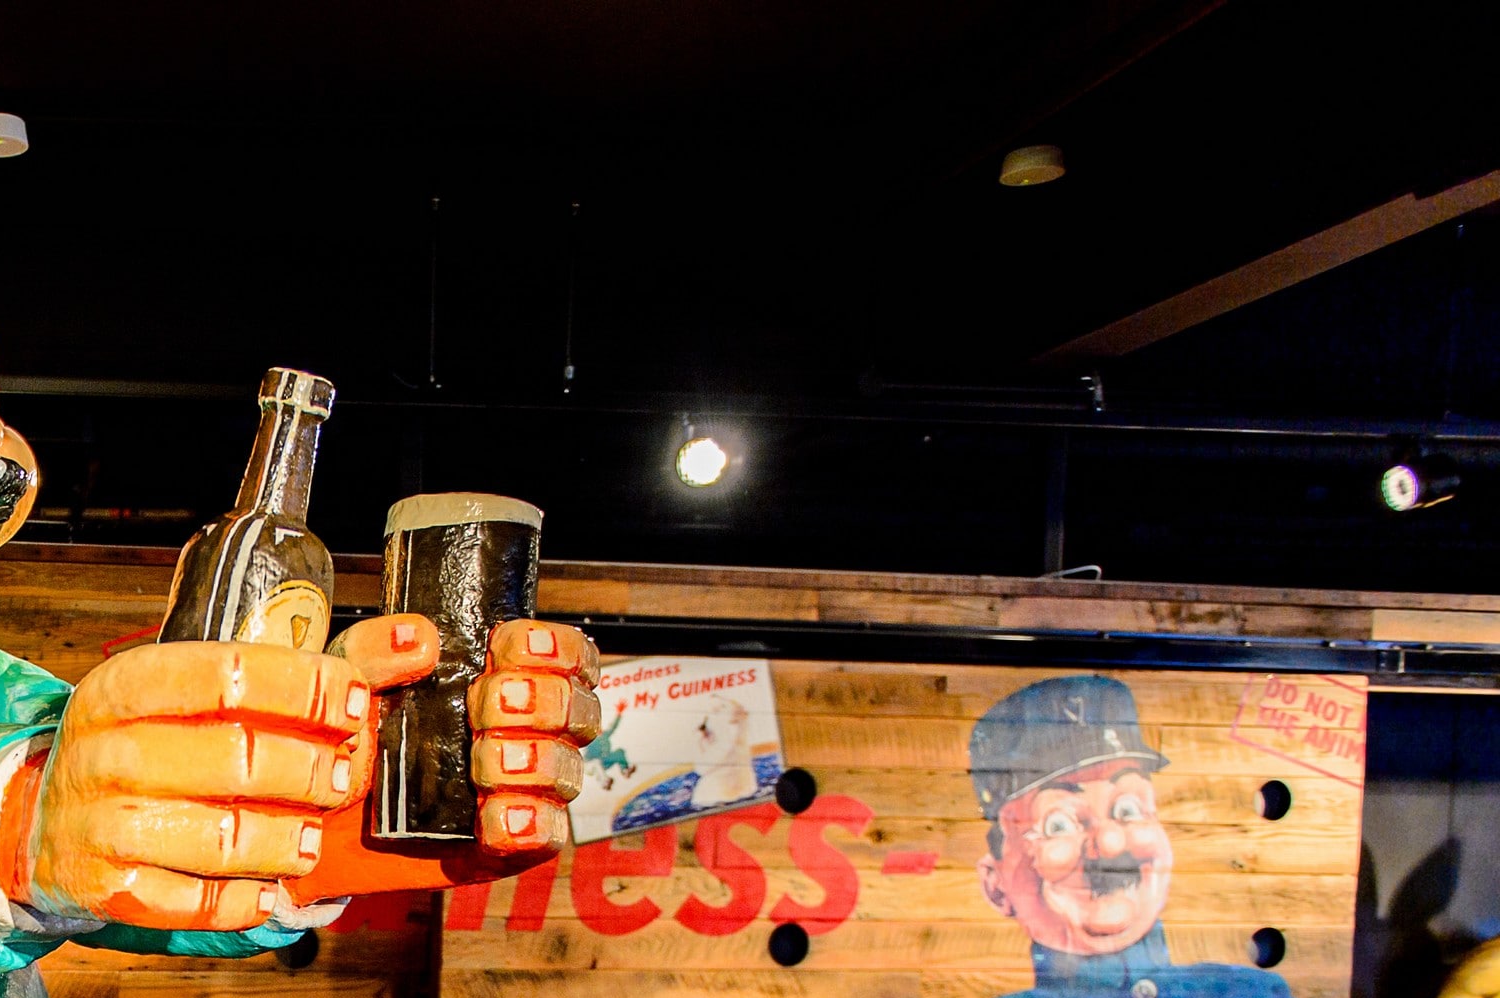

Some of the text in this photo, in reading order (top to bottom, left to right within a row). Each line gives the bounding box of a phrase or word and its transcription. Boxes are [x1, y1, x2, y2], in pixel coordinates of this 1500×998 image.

[600, 664, 681, 689] Goodness
[634, 669, 757, 709] My GUINNESS
[1265, 676, 1298, 705] DO
[1303, 691, 1355, 727] NOT
[1258, 706, 1299, 738] THE
